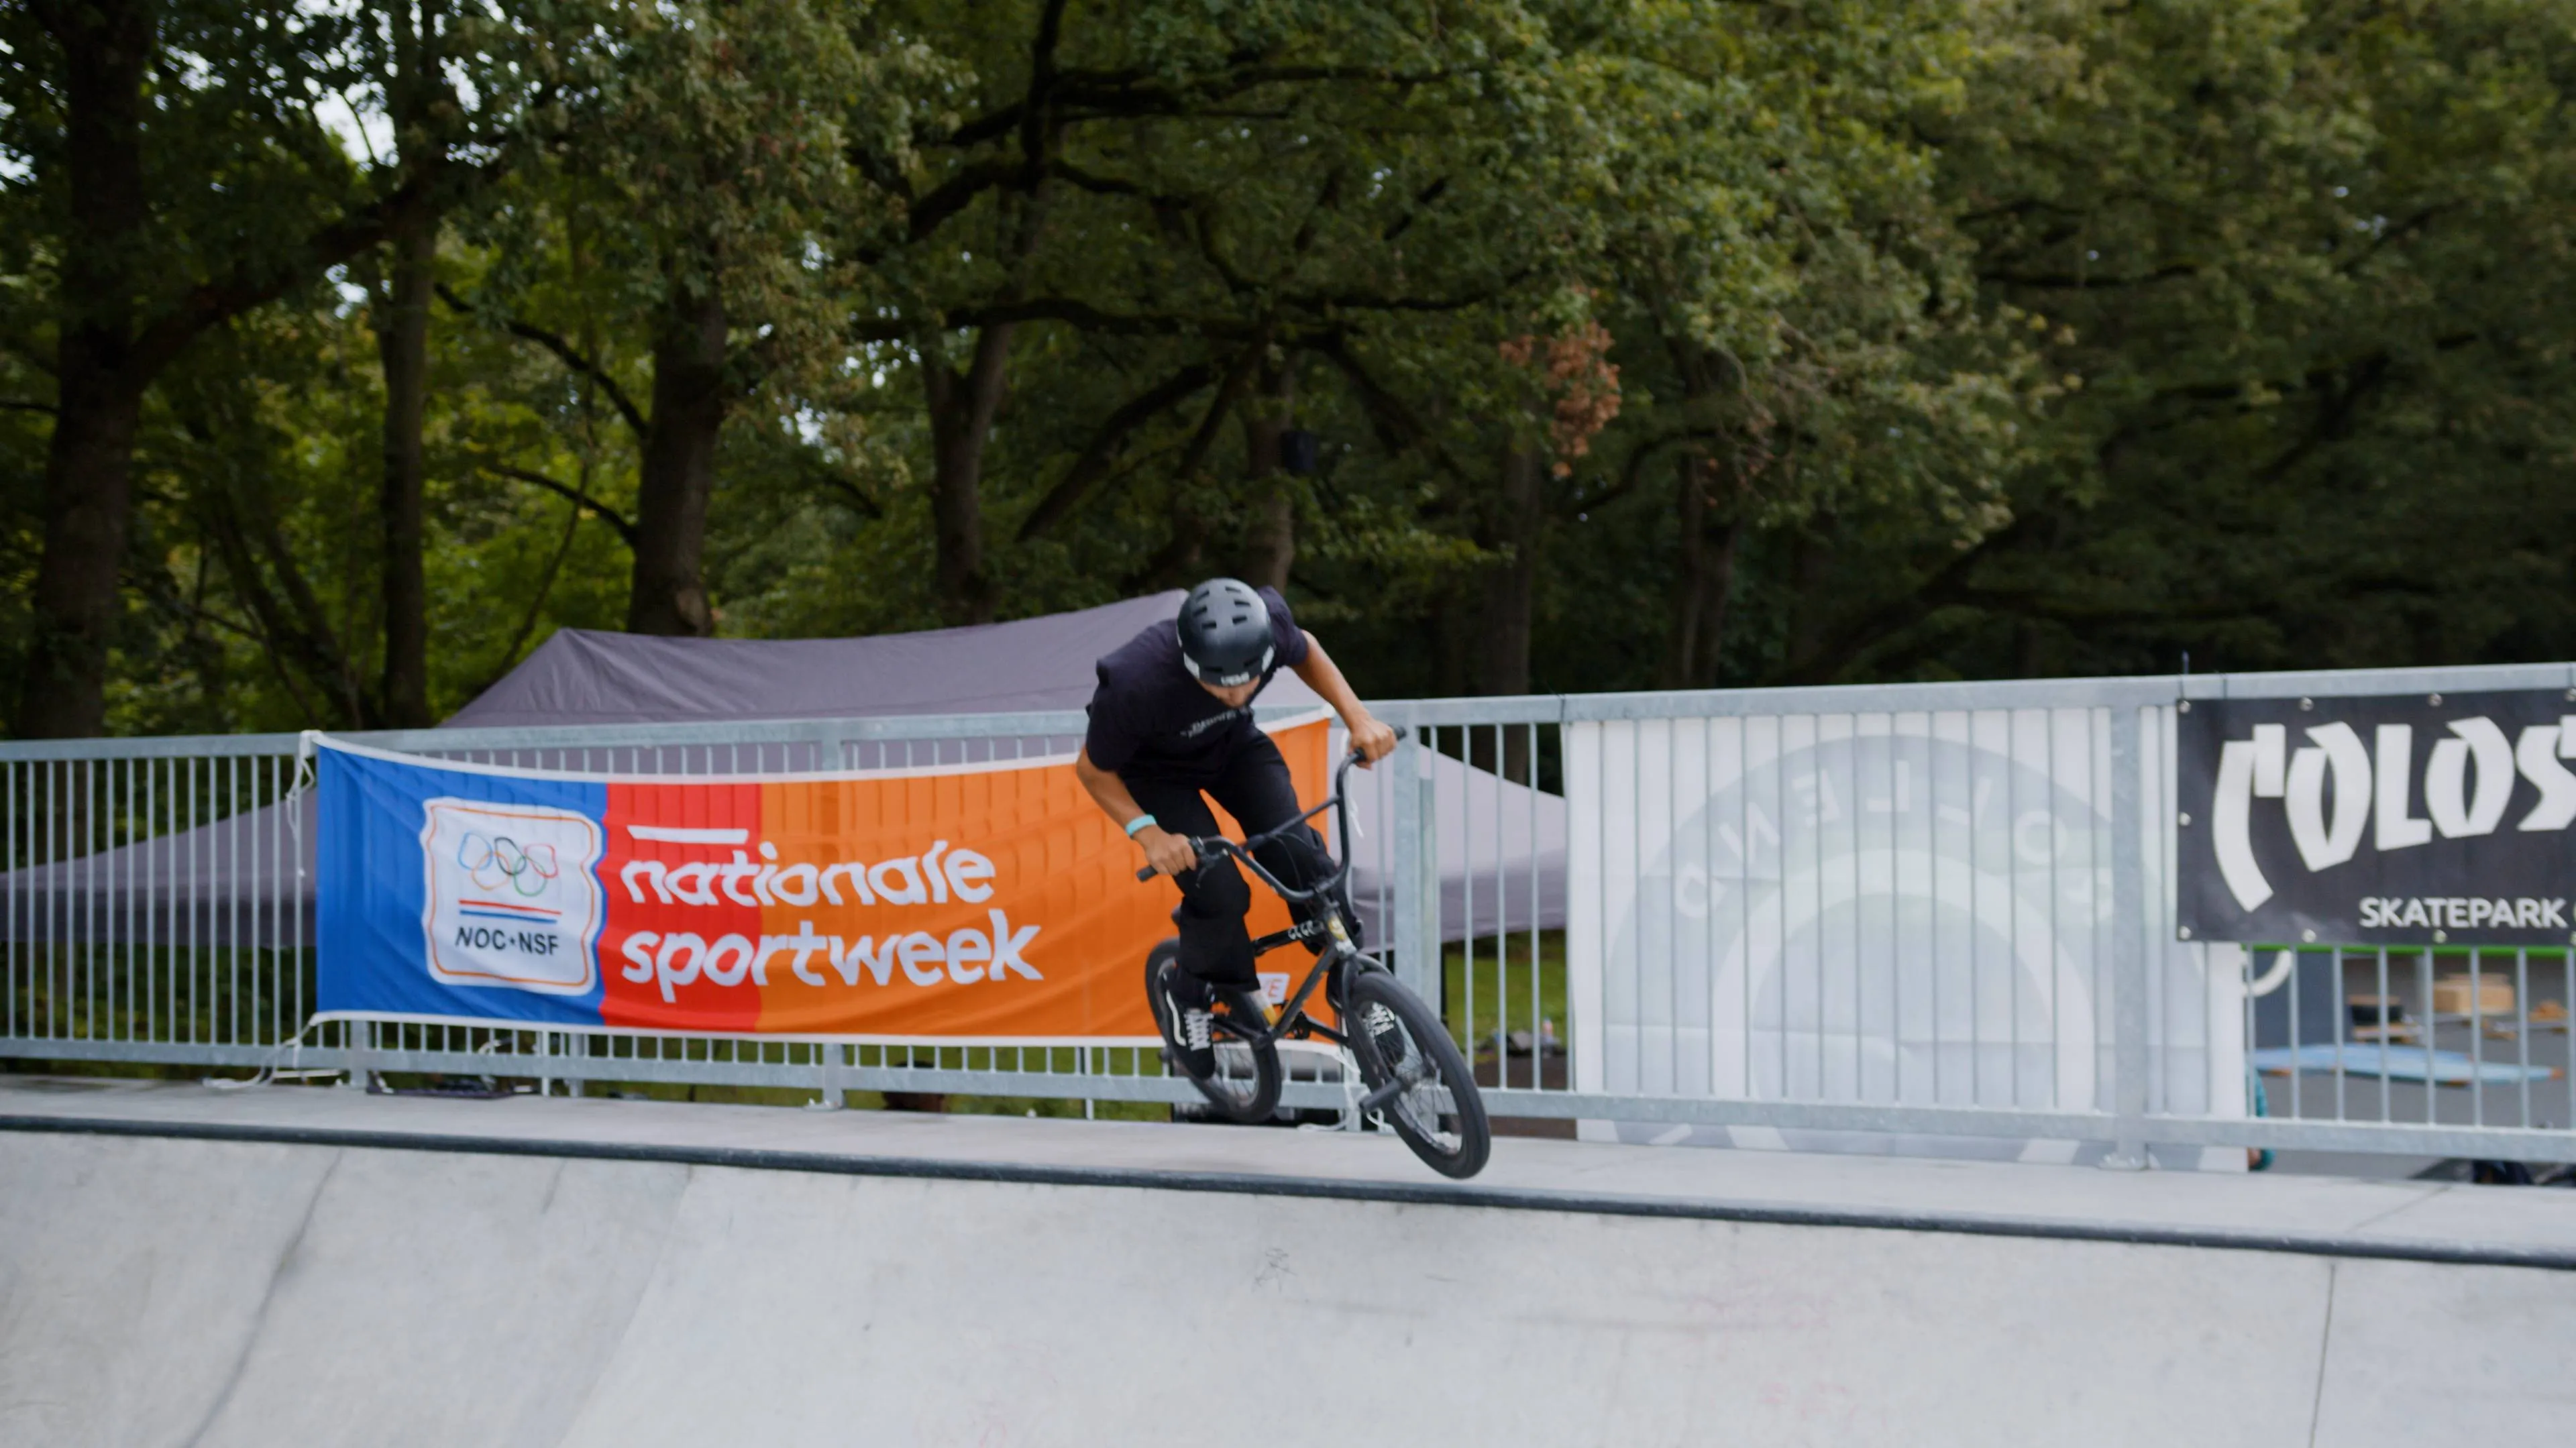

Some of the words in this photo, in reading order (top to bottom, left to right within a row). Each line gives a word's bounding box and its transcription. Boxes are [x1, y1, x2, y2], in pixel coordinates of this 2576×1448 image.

[620, 840, 996, 906] nationale
[2359, 897, 2568, 928] SKATEPARK
[621, 908, 1044, 1003] sportweek
